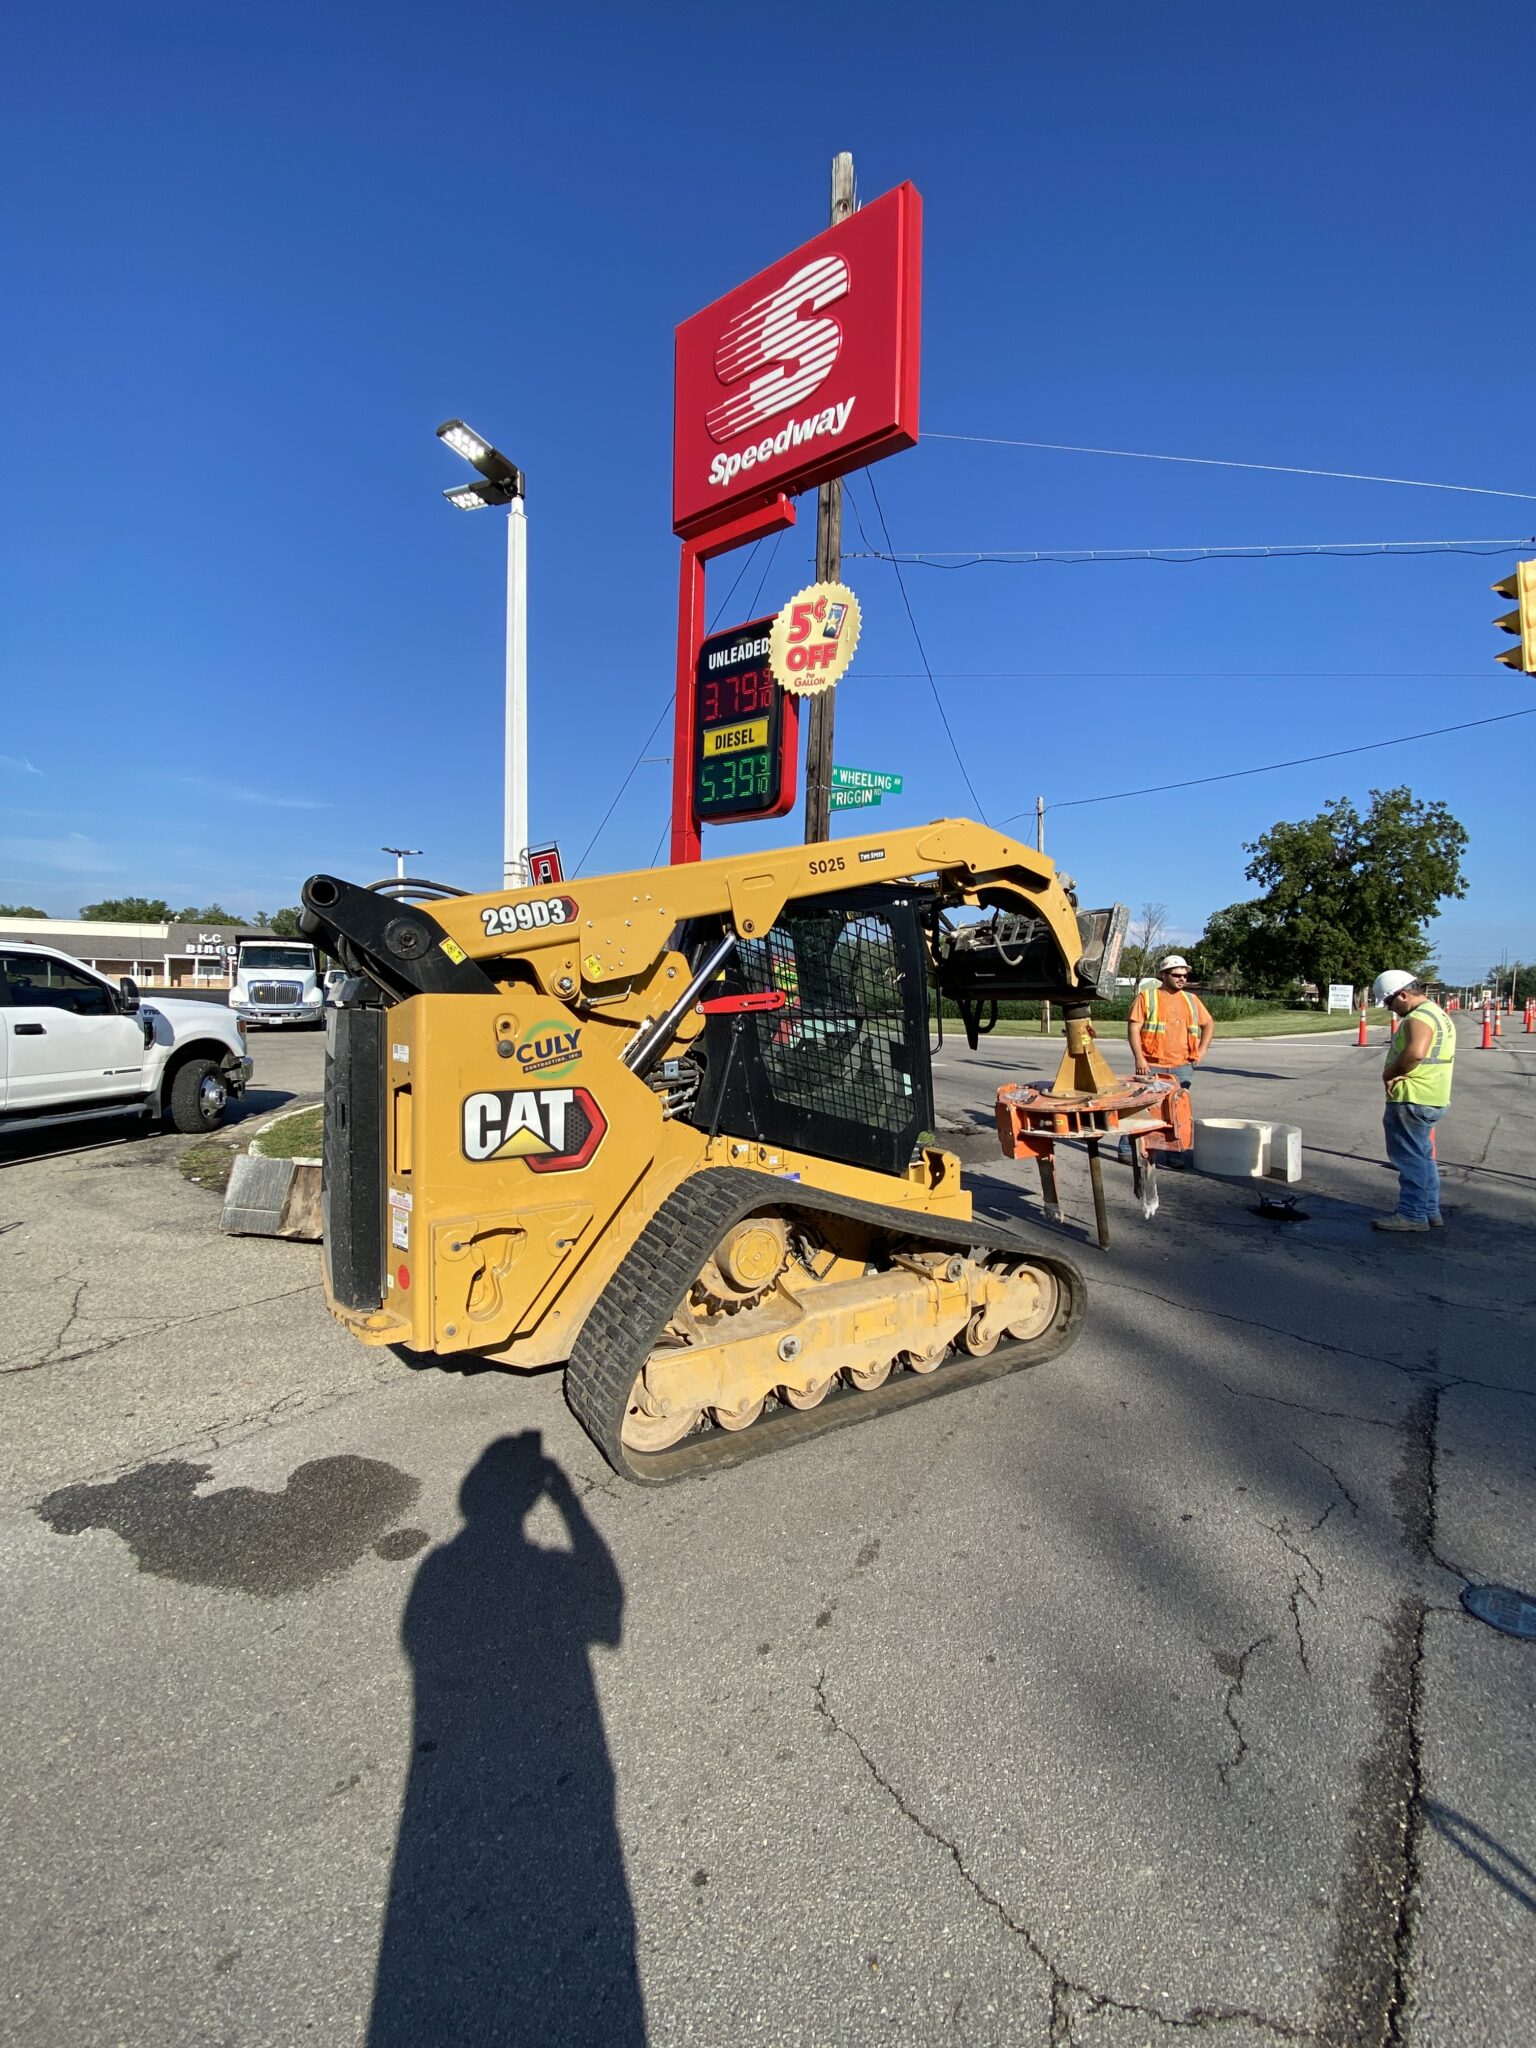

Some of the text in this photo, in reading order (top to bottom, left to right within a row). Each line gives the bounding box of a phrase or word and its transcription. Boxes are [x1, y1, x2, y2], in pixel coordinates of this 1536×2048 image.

[707, 396, 856, 486] Speedway
[708, 637, 769, 670] UNLEADED
[786, 641, 838, 671] OFF
[794, 677, 825, 687] GALLON
[715, 728, 755, 750] DIESEL
[840, 769, 892, 790] WHEELING
[836, 789, 873, 806] RIGGIN
[481, 898, 566, 936] 299D3
[516, 1028, 582, 1063] CULY
[464, 1089, 573, 1159] CAT
